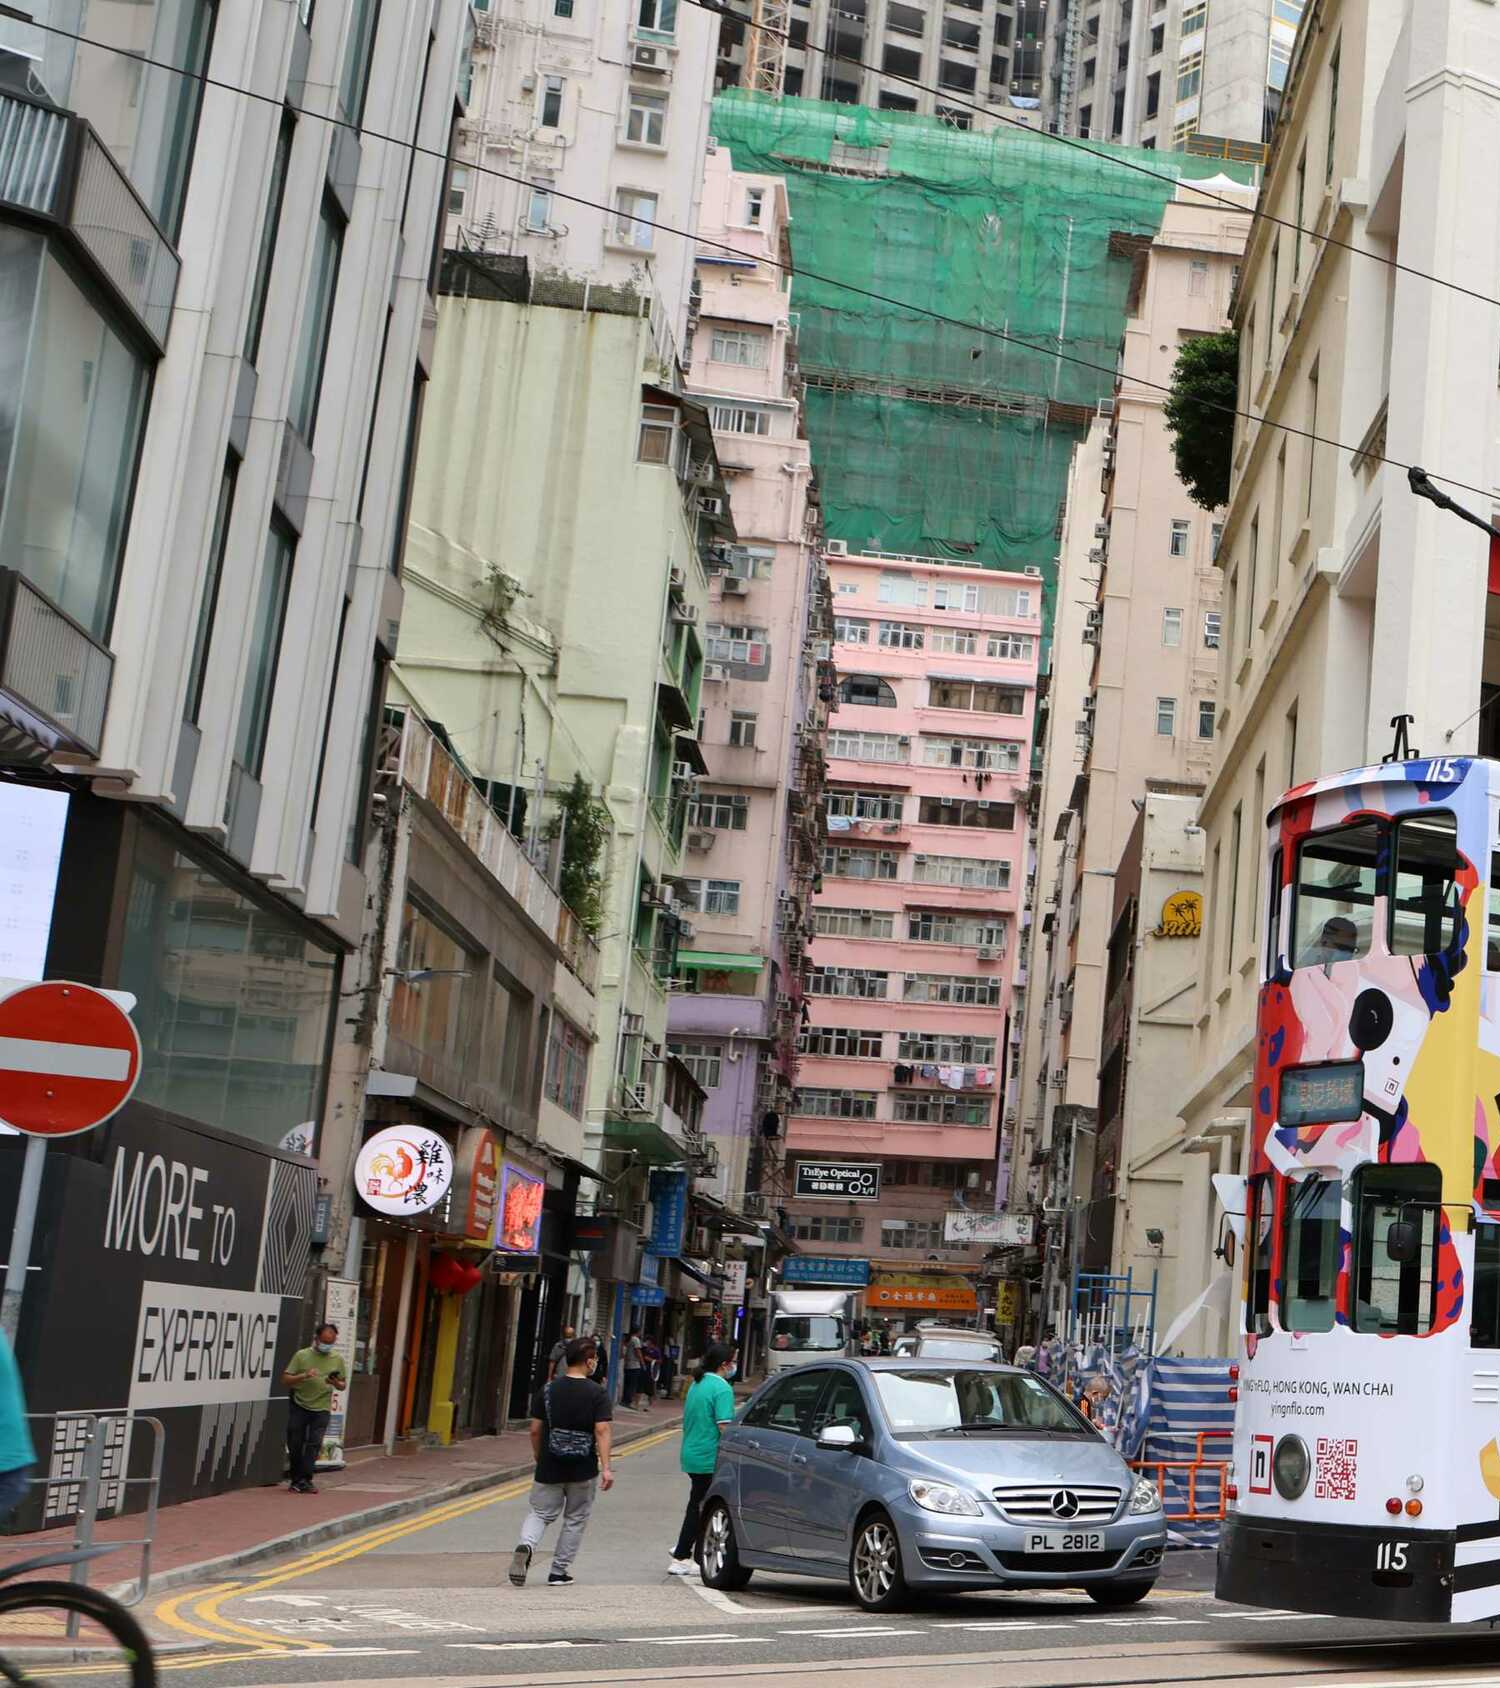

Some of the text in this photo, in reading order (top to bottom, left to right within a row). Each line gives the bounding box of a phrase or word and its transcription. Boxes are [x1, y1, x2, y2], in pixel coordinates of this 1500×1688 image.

[1425, 759, 1458, 781] 115
[830, 1168, 860, 1179] Optical
[104, 1145, 236, 1266] MORE TO
[138, 1306, 278, 1383] EXPERIENCE
[1273, 1381, 1297, 1393] HONG
[1299, 1381, 1330, 1398] KONG,
[1333, 1382, 1361, 1395] WAN
[1363, 1382, 1393, 1396] CHAI
[1031, 1535, 1099, 1550] PL 2812
[1376, 1542, 1409, 1570] 115
